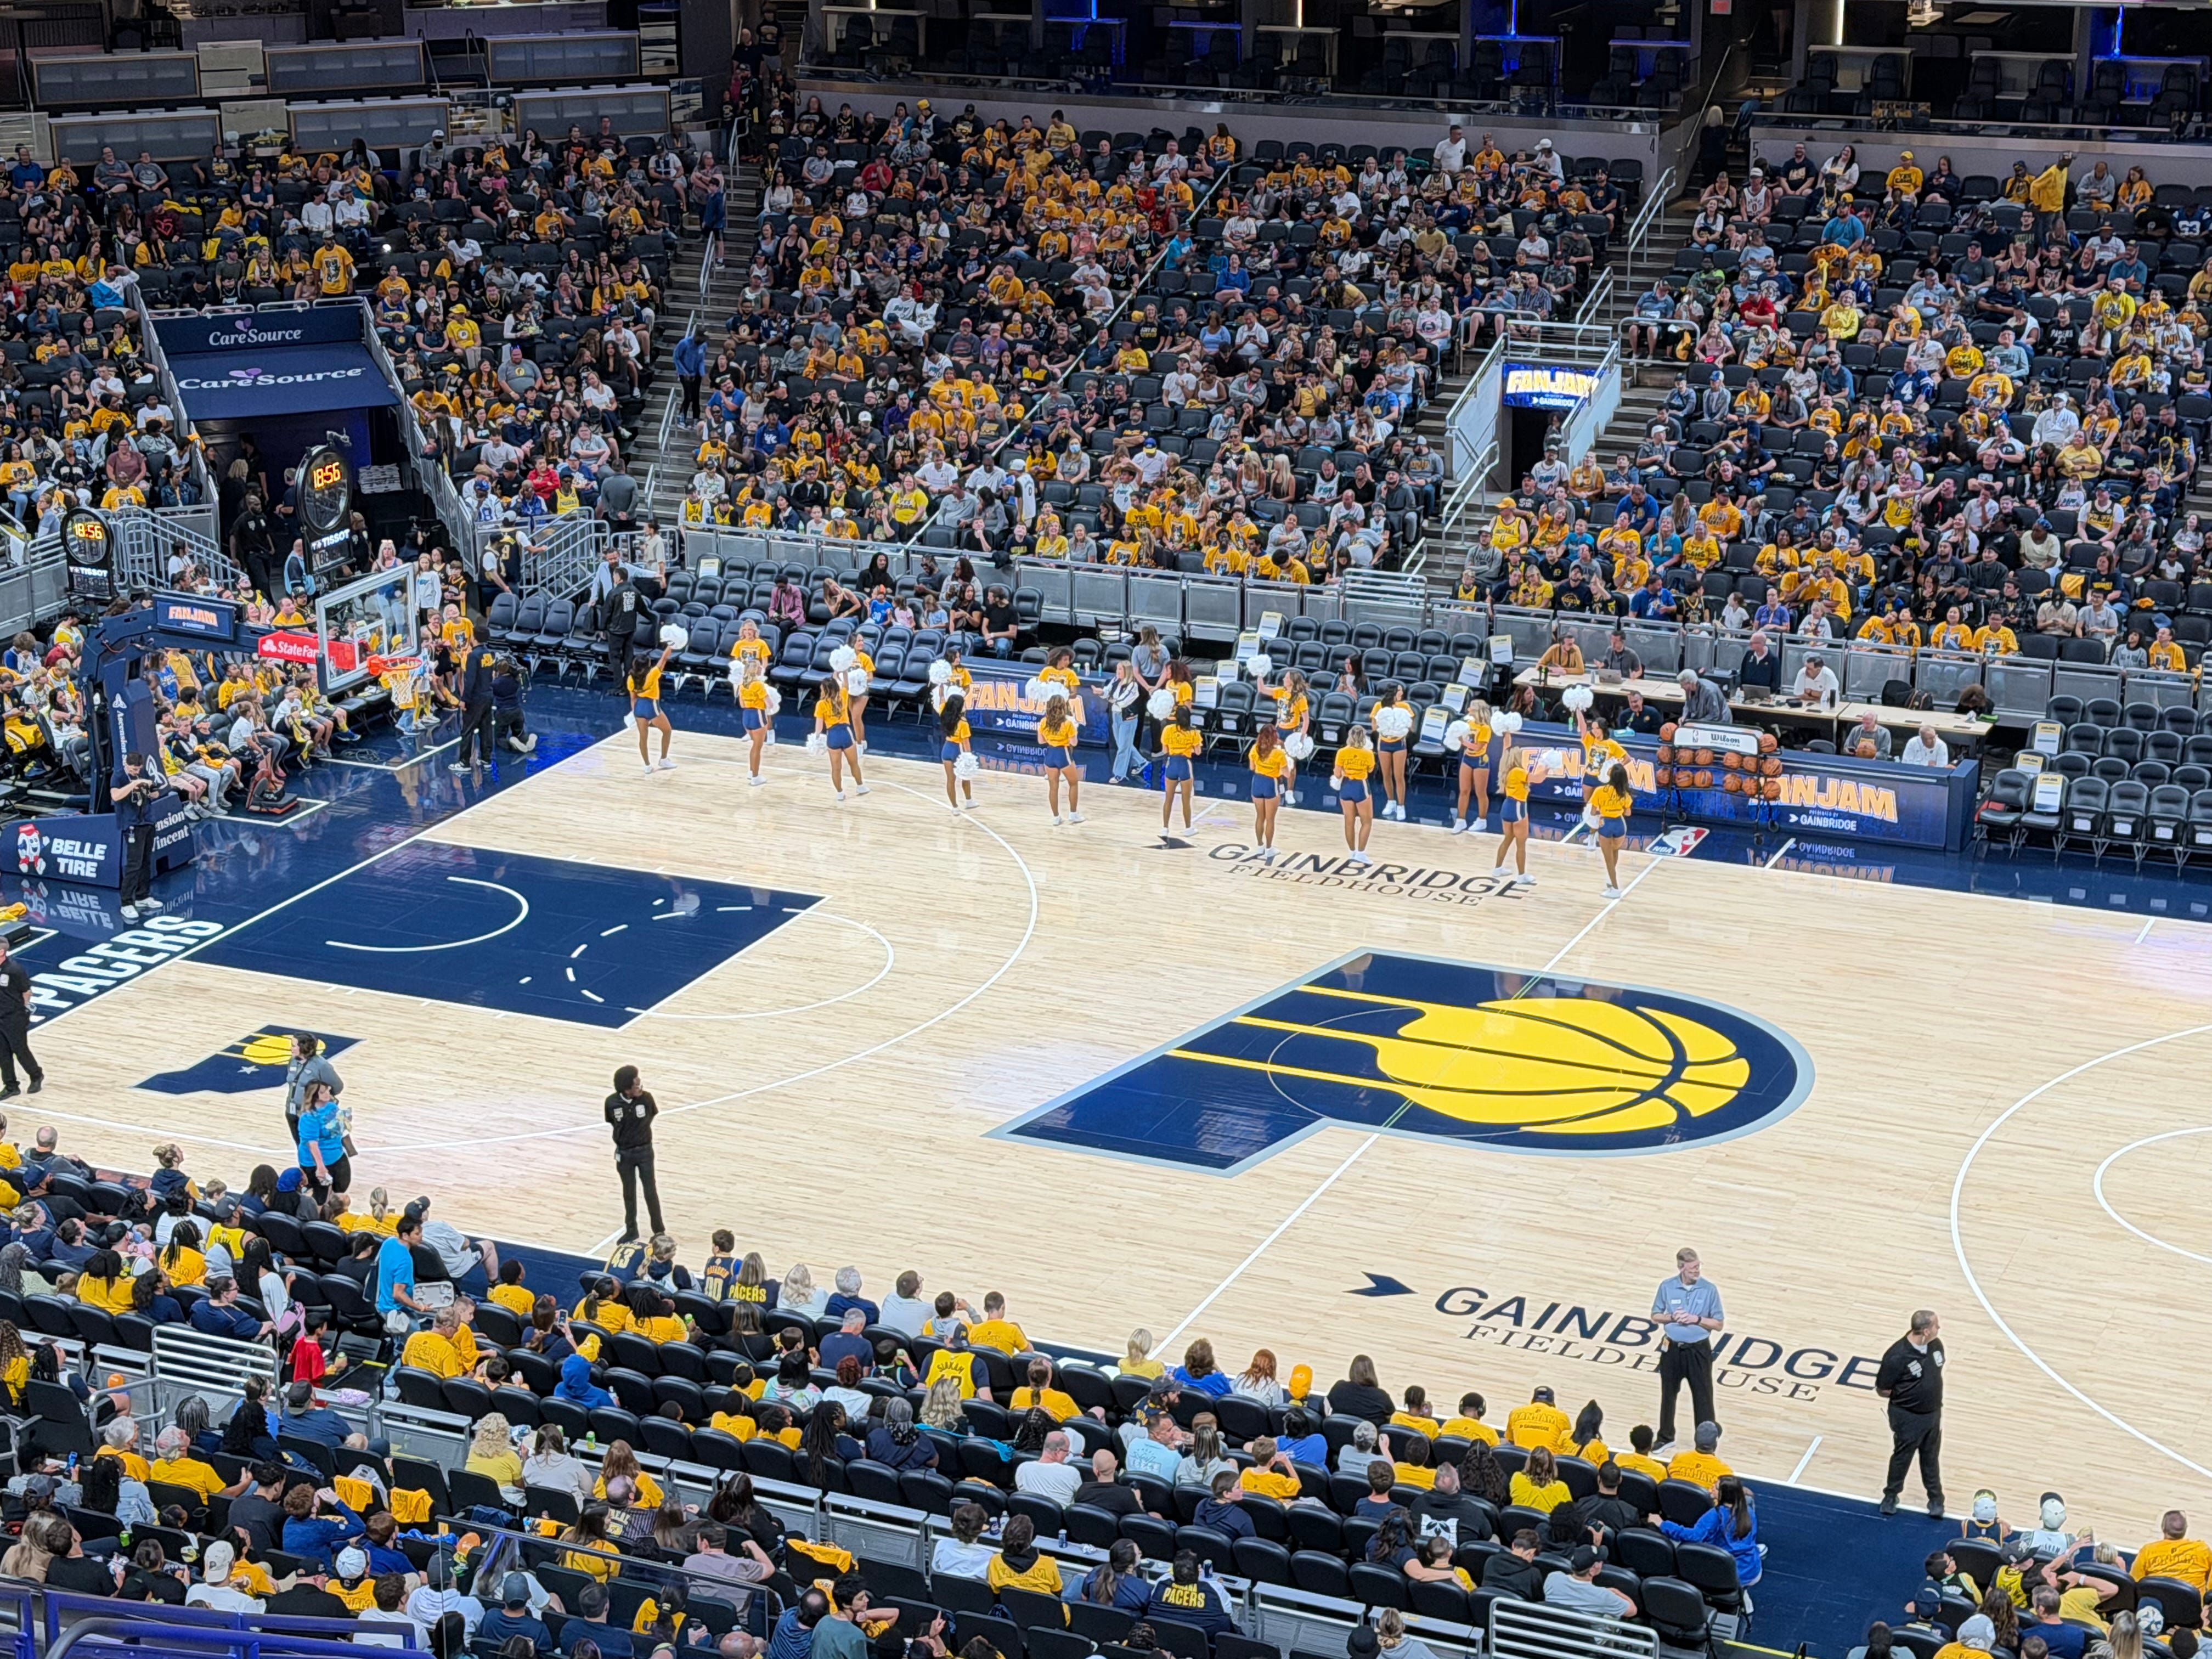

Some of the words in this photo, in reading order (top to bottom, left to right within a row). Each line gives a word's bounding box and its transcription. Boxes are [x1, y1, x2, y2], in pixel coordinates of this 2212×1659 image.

[1650, 138, 1655, 154] 4
[1752, 141, 1760, 158] 5
[208, 329, 302, 346] CareSource
[178, 367, 363, 390] CareSource
[1900, 381, 1914, 401] 4
[312, 461, 342, 489] 18:56
[74, 523, 104, 540] 18:56
[322, 528, 351, 548] TISSOT
[81, 568, 109, 577] TISSOT
[168, 606, 218, 627] FANJAM
[276, 641, 319, 659] StateFar
[964, 681, 1087, 726] FANJM
[1005, 718, 1040, 731] GAINBRI
[1711, 733, 1740, 744] Wilson
[1748, 774, 1898, 823] ANJAM
[155, 810, 185, 832] nsion
[1800, 814, 1858, 832] GAINBRIDGE
[50, 838, 108, 861] BELLE
[1652, 845, 1673, 854] NBA
[57, 857, 98, 878] TIRE
[1207, 843, 1538, 900] GAINBRIDGE
[1224, 864, 1484, 906] FIELDHOUSE
[27, 915, 224, 1009] PACERS
[611, 1246, 636, 1269] 43
[704, 1276, 724, 1302] 00
[729, 1281, 767, 1302] PACERS
[1434, 1286, 1883, 1391] GAINBIDGE
[1459, 1322, 1822, 1403] FIELDHUSE
[1680, 1466, 1718, 1485] ANJAM
[1161, 1587, 1206, 1609] PACERS
